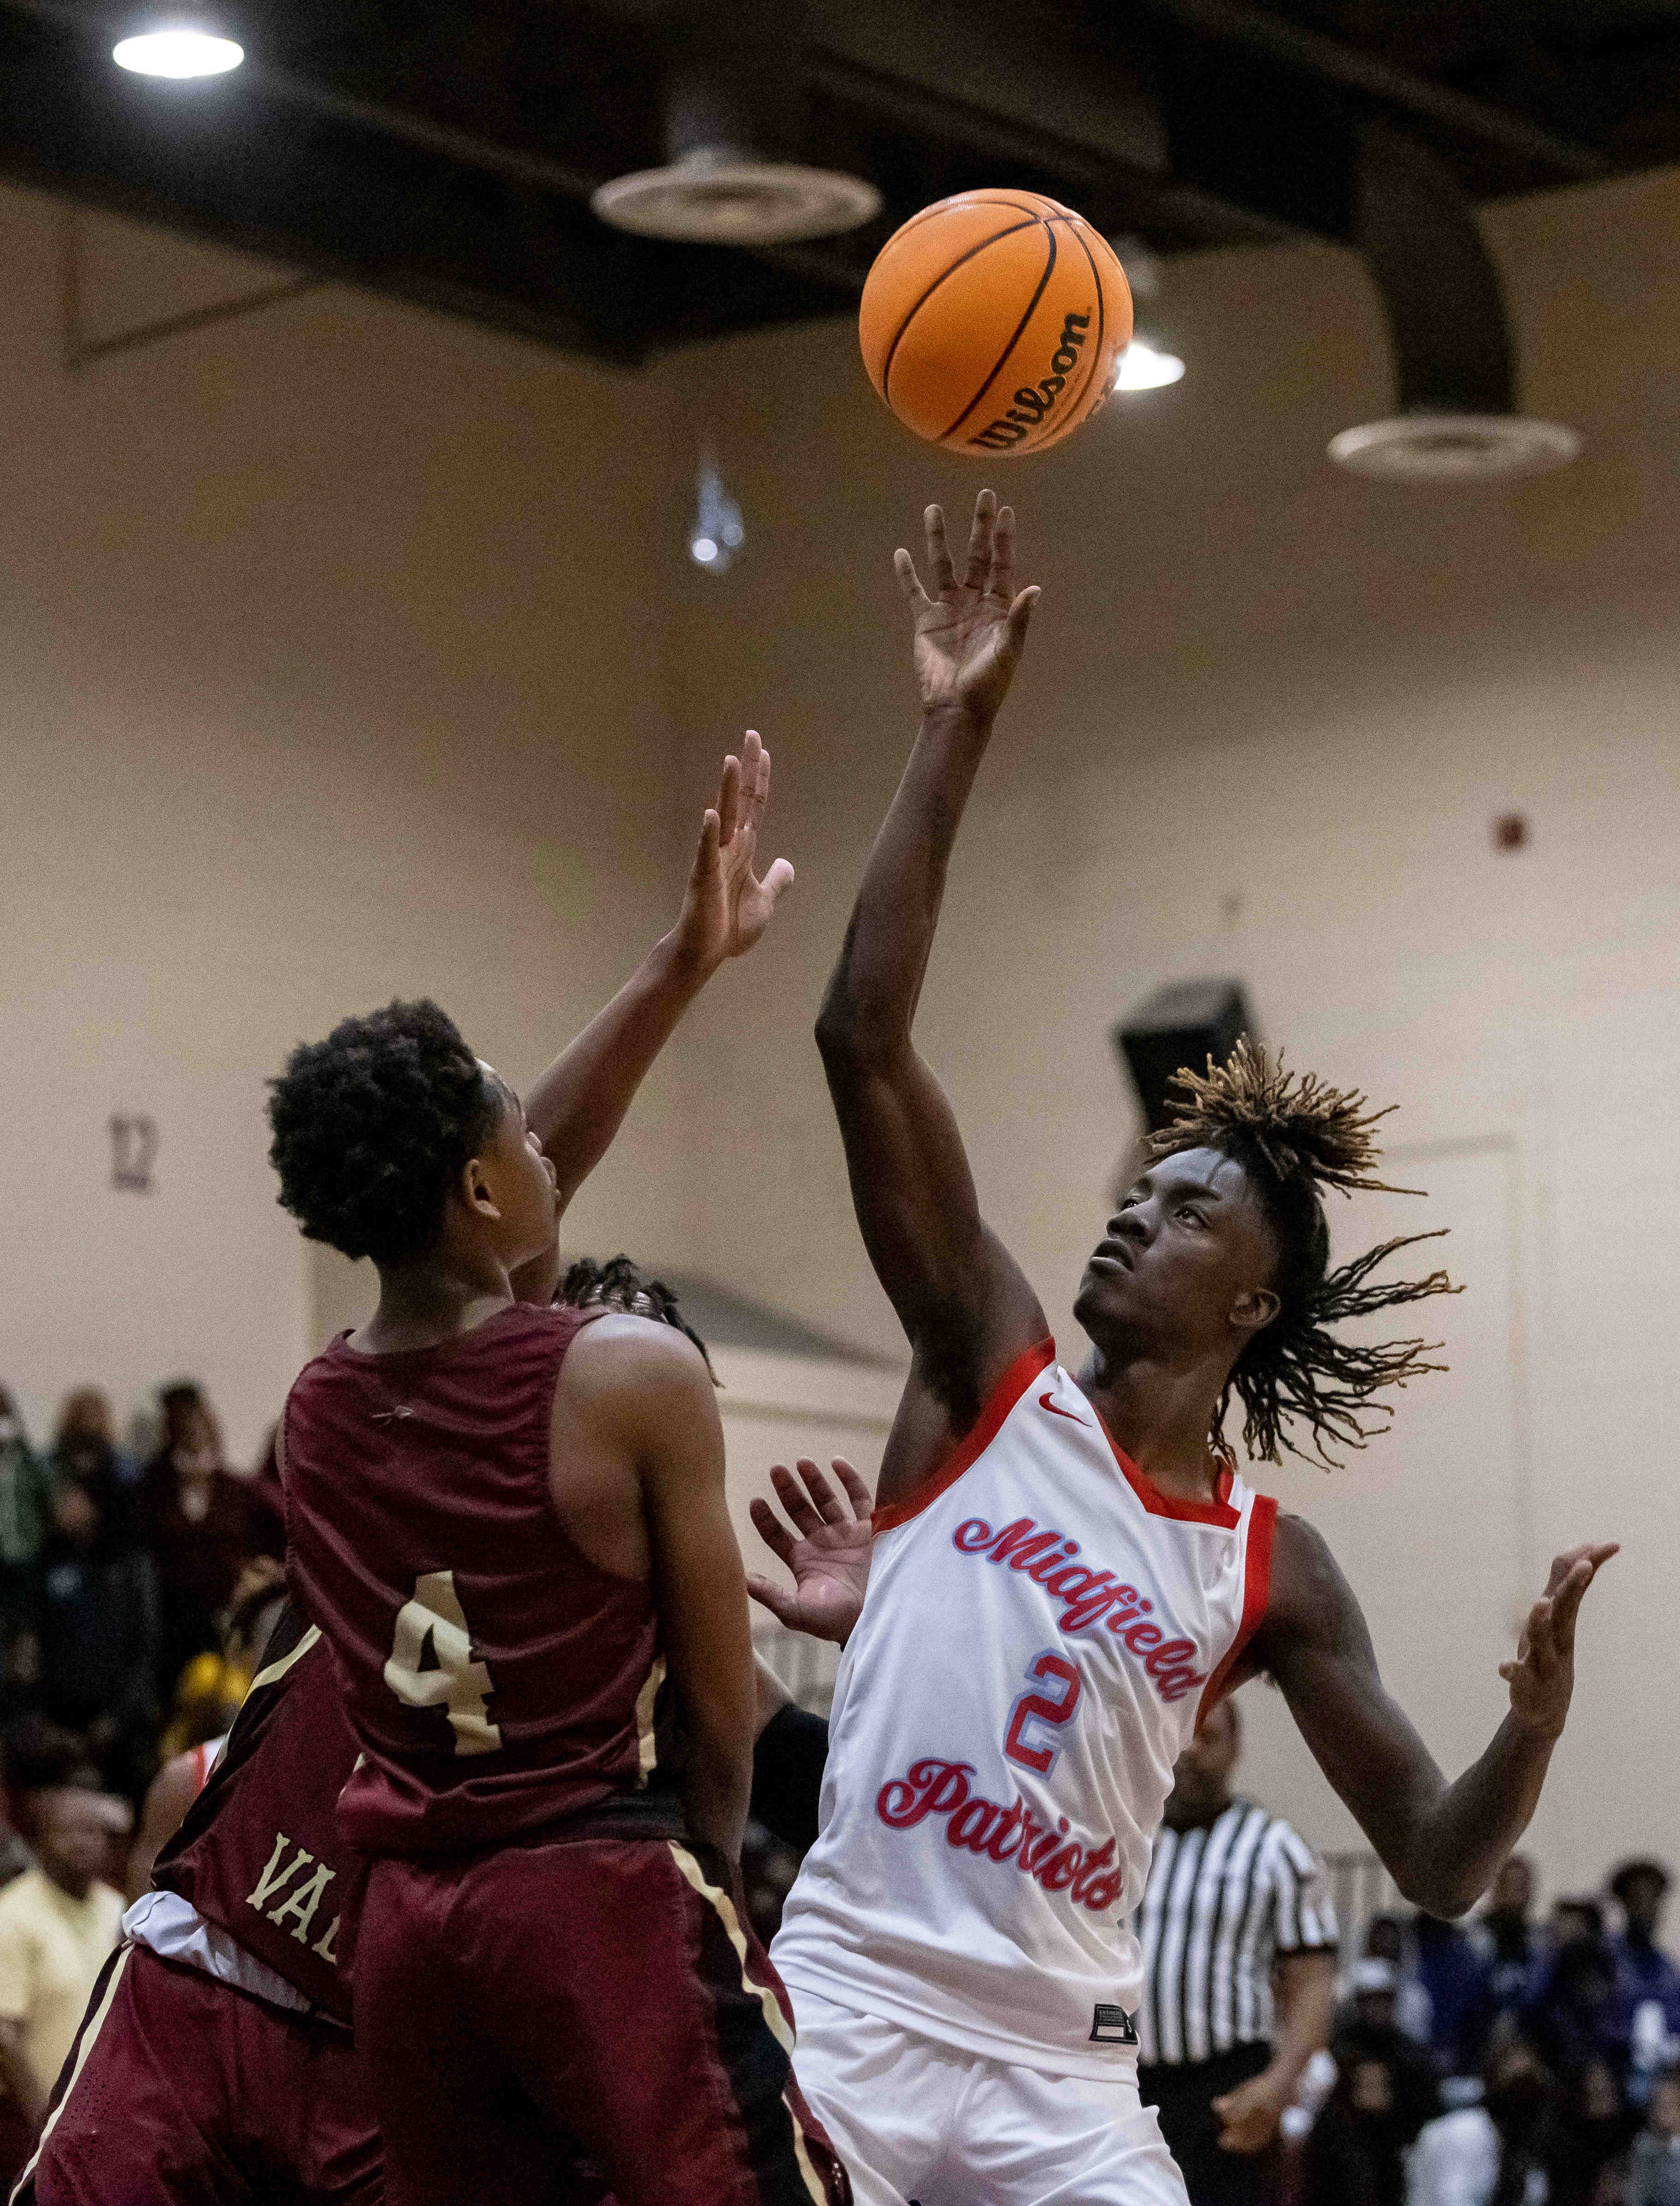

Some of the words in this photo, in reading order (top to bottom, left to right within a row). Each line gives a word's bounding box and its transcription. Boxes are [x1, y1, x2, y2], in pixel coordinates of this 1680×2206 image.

[968, 313, 1091, 450] Wilson
[384, 1570, 503, 1756] 4
[953, 1517, 1207, 1702] Midfield
[1004, 1651, 1082, 1776] 2
[877, 1758, 1124, 1911] Patriots
